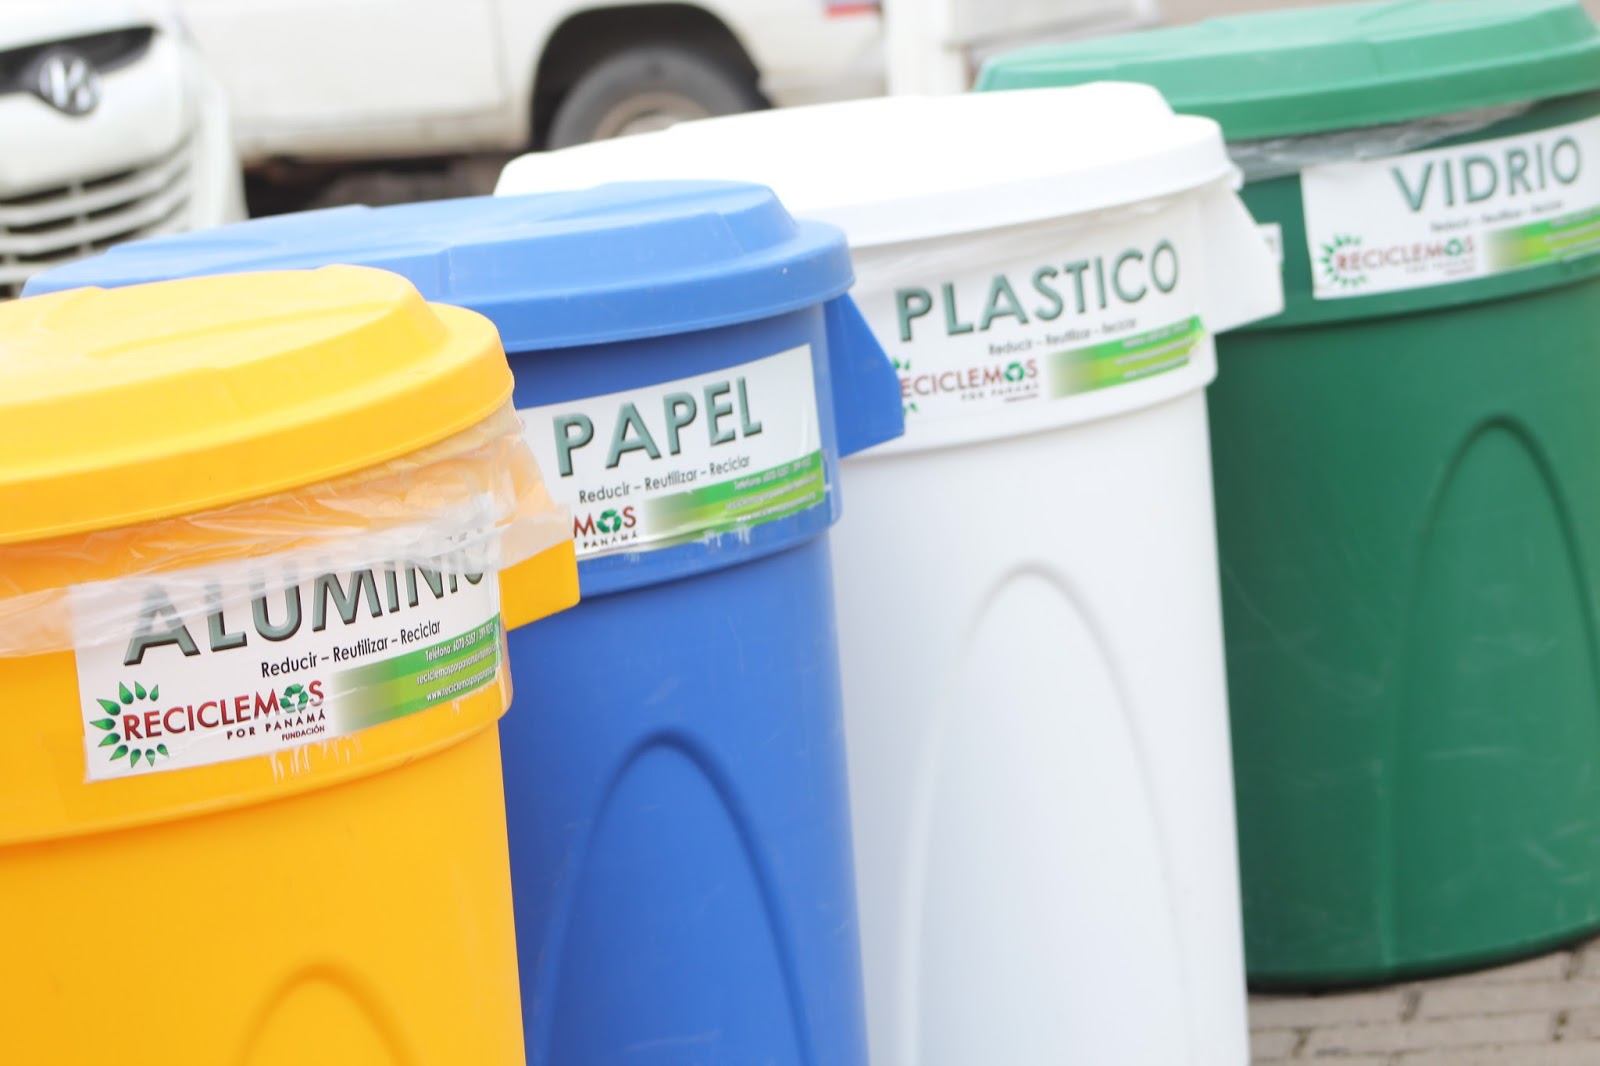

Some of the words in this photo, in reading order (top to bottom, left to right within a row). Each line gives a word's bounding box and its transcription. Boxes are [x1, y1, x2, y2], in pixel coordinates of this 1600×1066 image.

[1391, 136, 1582, 213] VIDRIO
[895, 239, 1179, 342] PLASTICO
[901, 359, 1038, 398] ECICLEMOS
[552, 375, 762, 477] PAPEL
[579, 481, 630, 504] Reducir
[645, 468, 697, 491] Reutilizar
[709, 455, 750, 476] Reciclar
[261, 651, 318, 678] Reducir
[333, 636, 389, 662] Reutilizar
[400, 619, 441, 645] Reciclar
[123, 680, 325, 741] RECICLEMOS
[227, 724, 256, 740] POR
[265, 708, 326, 732] PANAMÁ
[281, 724, 326, 742] FUNDACIÓN
